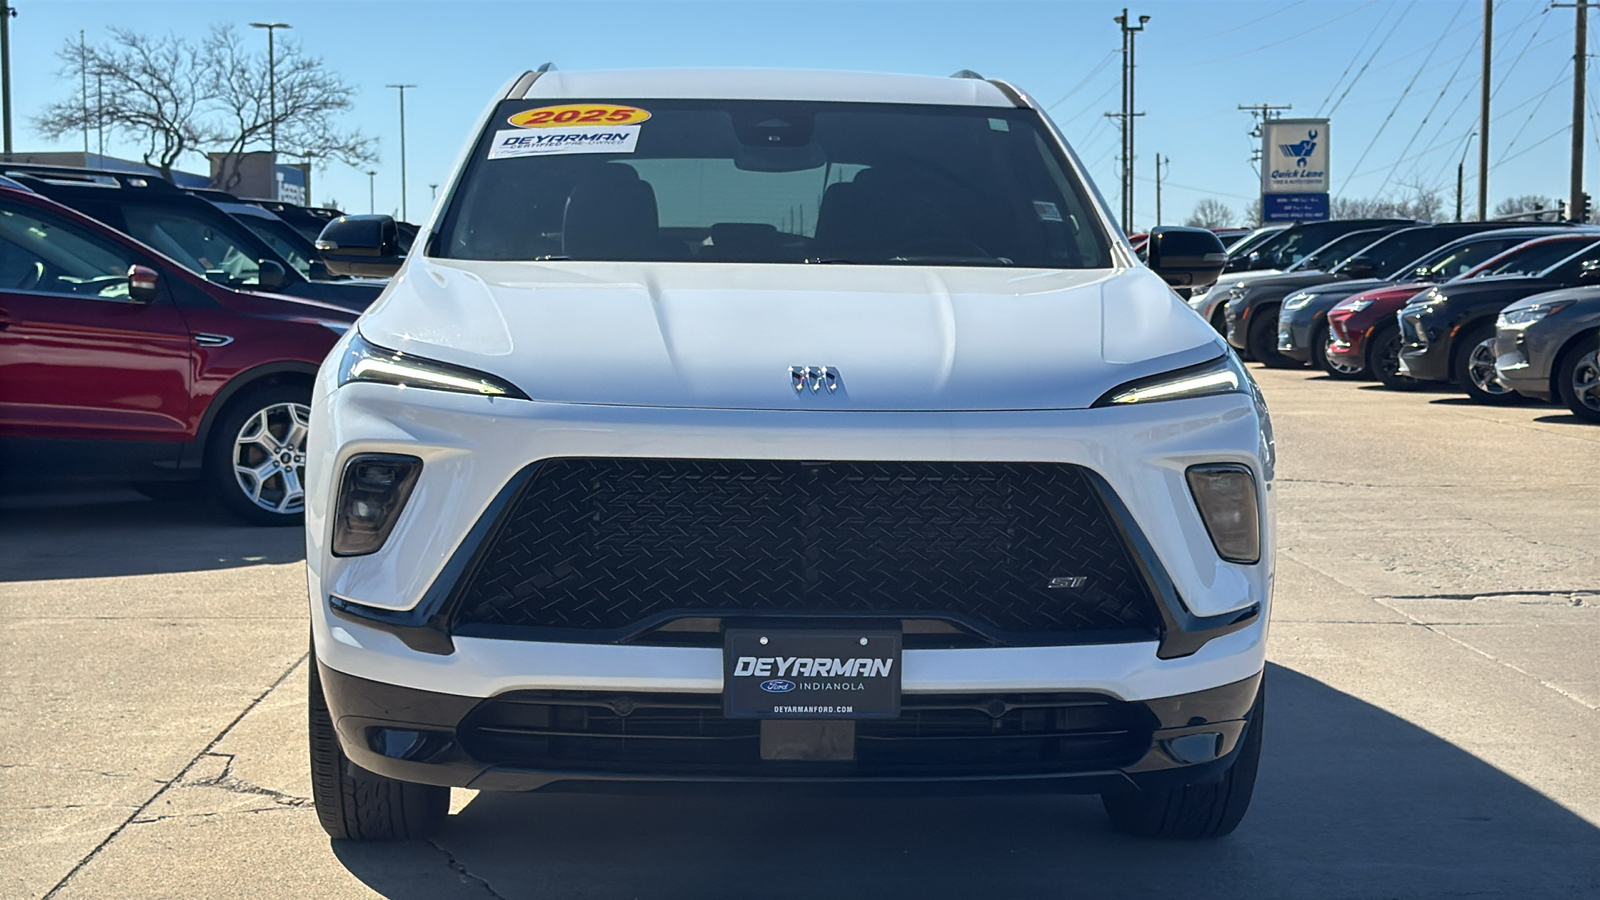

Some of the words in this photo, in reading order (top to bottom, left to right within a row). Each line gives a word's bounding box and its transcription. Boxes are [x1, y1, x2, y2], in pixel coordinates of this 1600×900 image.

[523, 109, 636, 125] 2025
[502, 132, 631, 147] DEYARMAN
[510, 141, 562, 150] CERTIFIED
[565, 139, 625, 147] PRE-OWNED
[1271, 169, 1299, 179] Quick
[1300, 169, 1324, 178] Lane
[733, 656, 893, 677] DEYARMAN
[800, 682, 865, 691] INDIANOLA
[774, 705, 853, 713] DEYARMANFORD.COM
